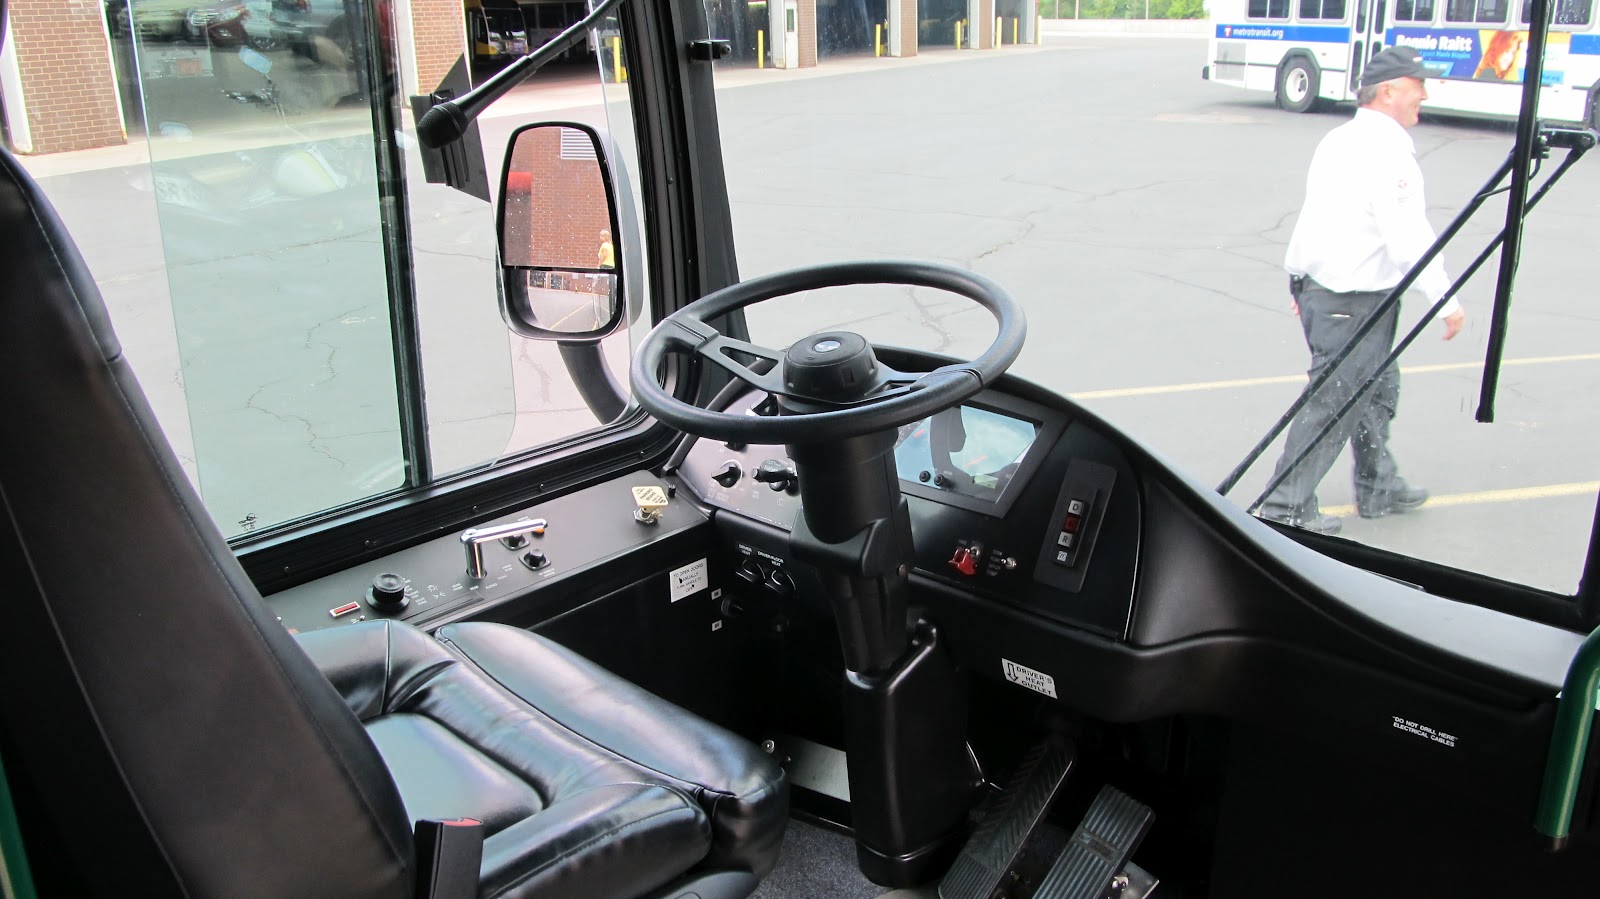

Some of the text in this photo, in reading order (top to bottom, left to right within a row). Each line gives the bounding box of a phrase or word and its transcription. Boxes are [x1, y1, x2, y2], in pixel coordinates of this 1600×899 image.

[1233, 27, 1284, 39] metrotransit.org
[1396, 34, 1473, 52] Bonnie Raitt
[1062, 535, 1068, 543] R
[1017, 667, 1052, 684] DRIVER'S
[1026, 676, 1044, 687] HEAT
[1021, 680, 1052, 696] OUTLET
[1393, 721, 1455, 748] ELECTRICAL CABLES
[1405, 720, 1419, 729] NOT
[1420, 725, 1437, 736] DRILL
